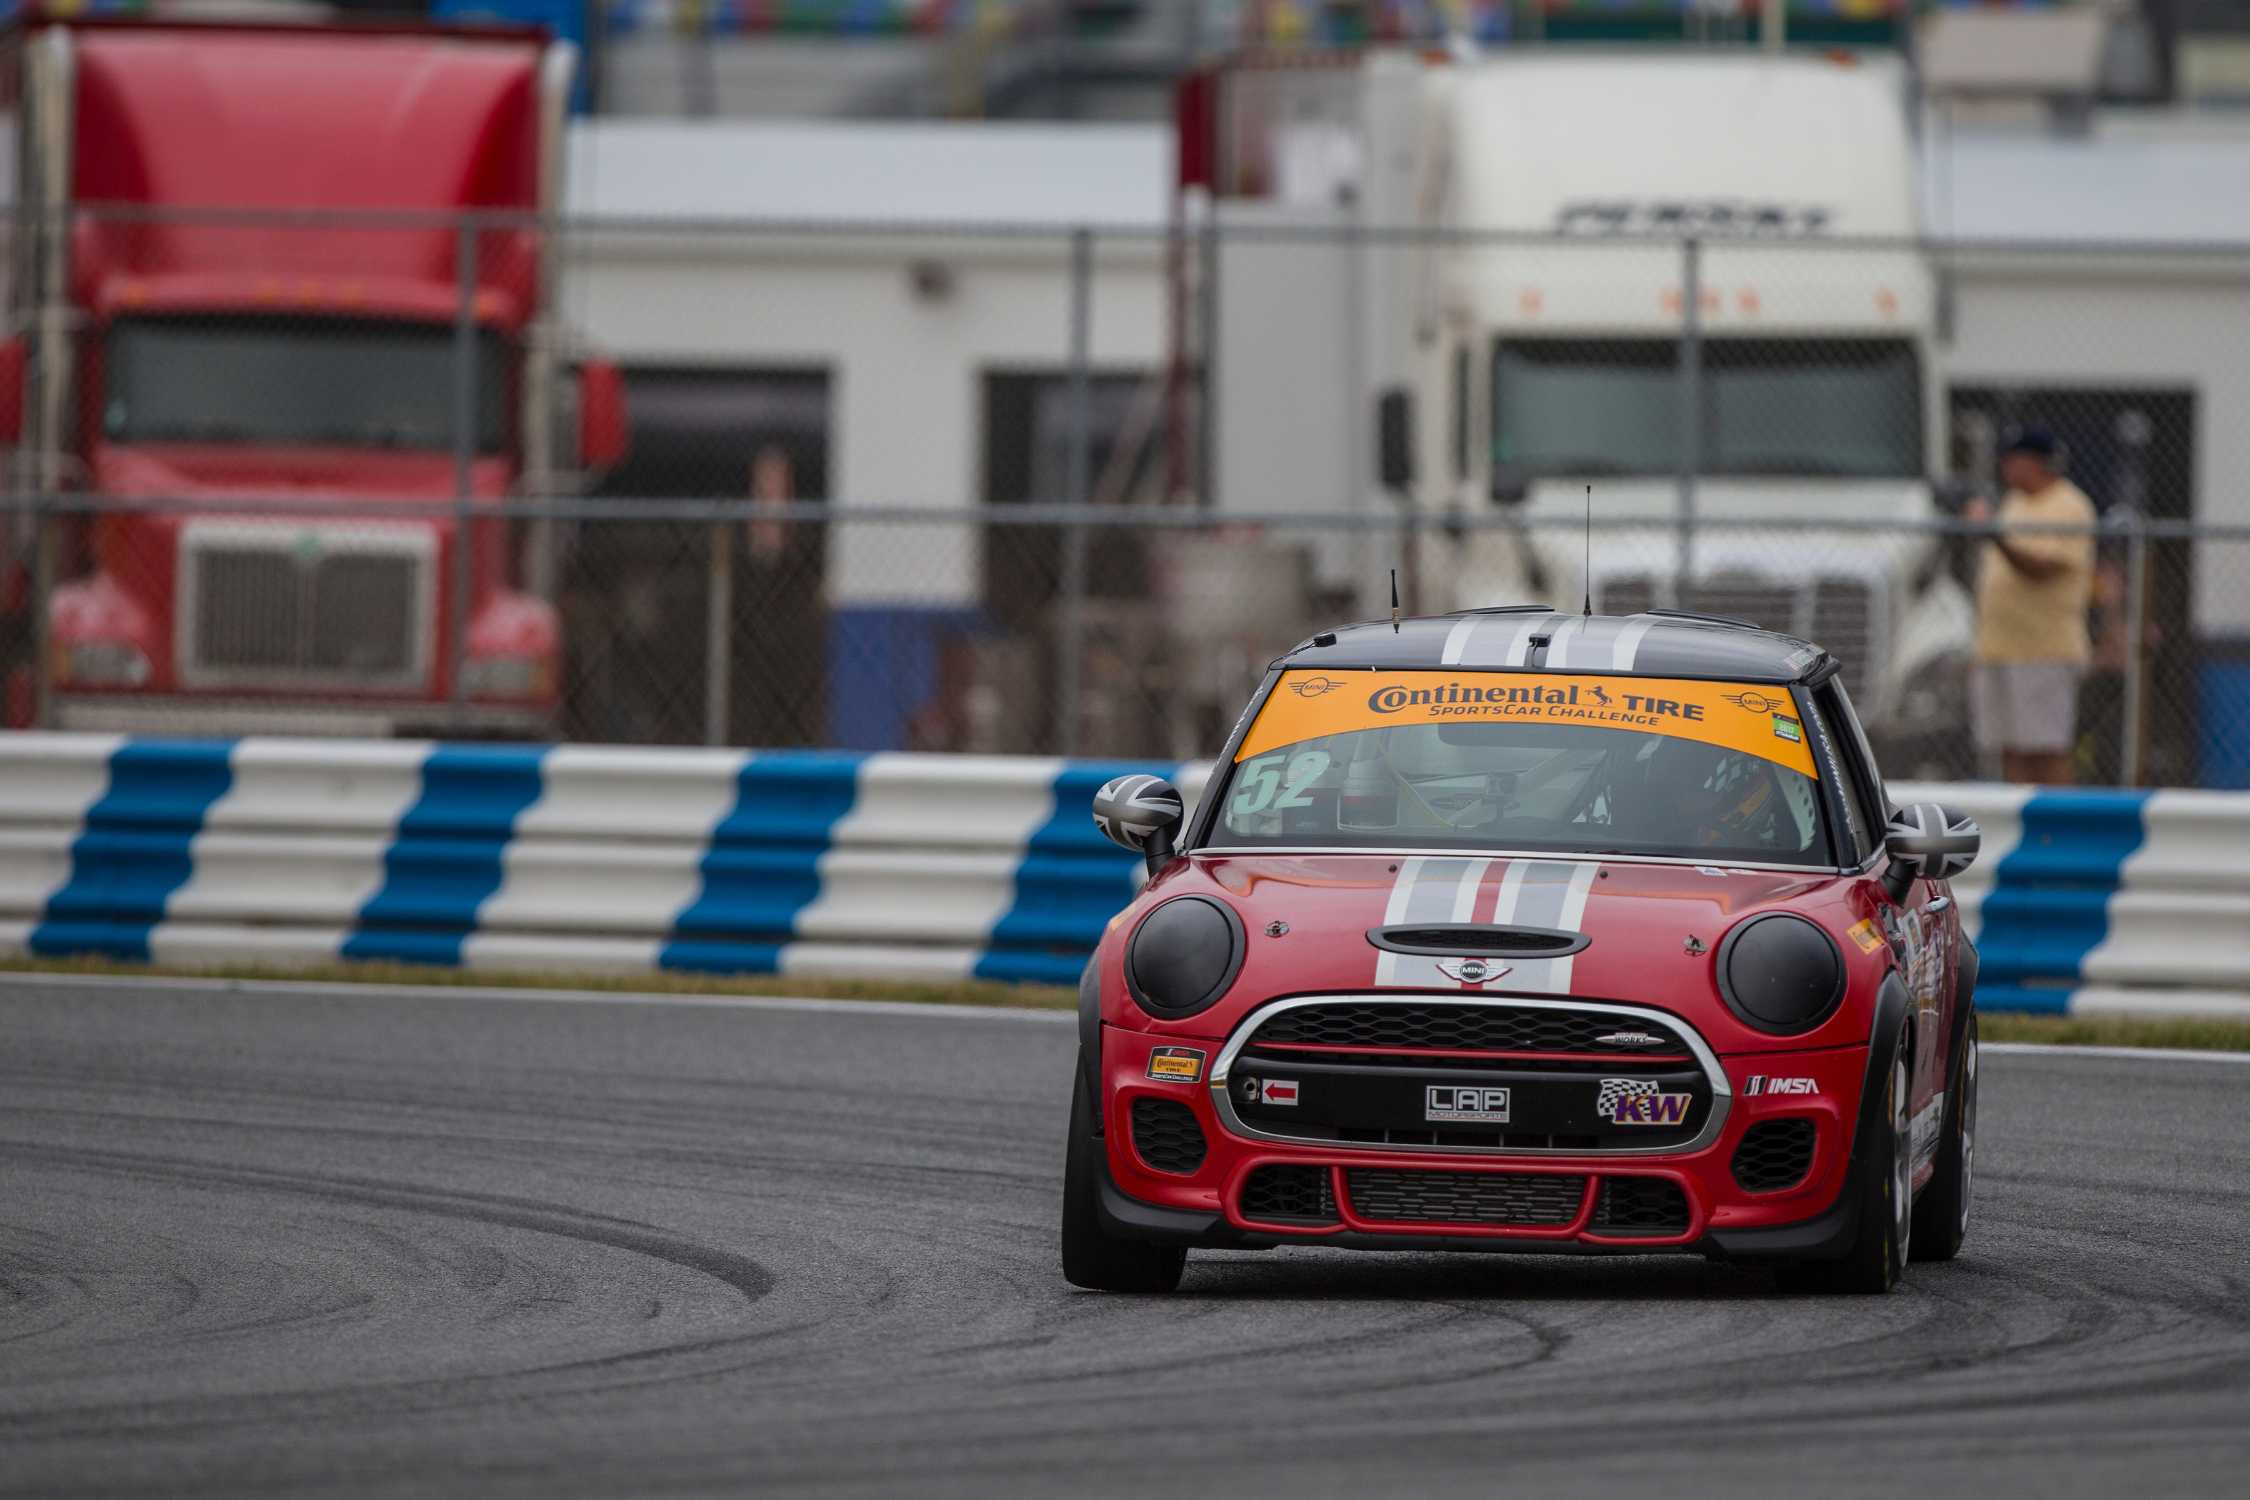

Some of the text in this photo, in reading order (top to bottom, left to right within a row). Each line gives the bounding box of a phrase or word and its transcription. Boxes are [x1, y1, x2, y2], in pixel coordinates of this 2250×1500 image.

[1368, 683, 1705, 722] Continental TIRE
[1547, 705, 1661, 727] CHALLENGE
[1231, 751, 1331, 816] 52
[1462, 966, 1485, 975] MINI
[1767, 1078, 1819, 1095] IMSA
[1431, 1089, 1506, 1111] LAP
[1615, 1093, 1690, 1123] KW
